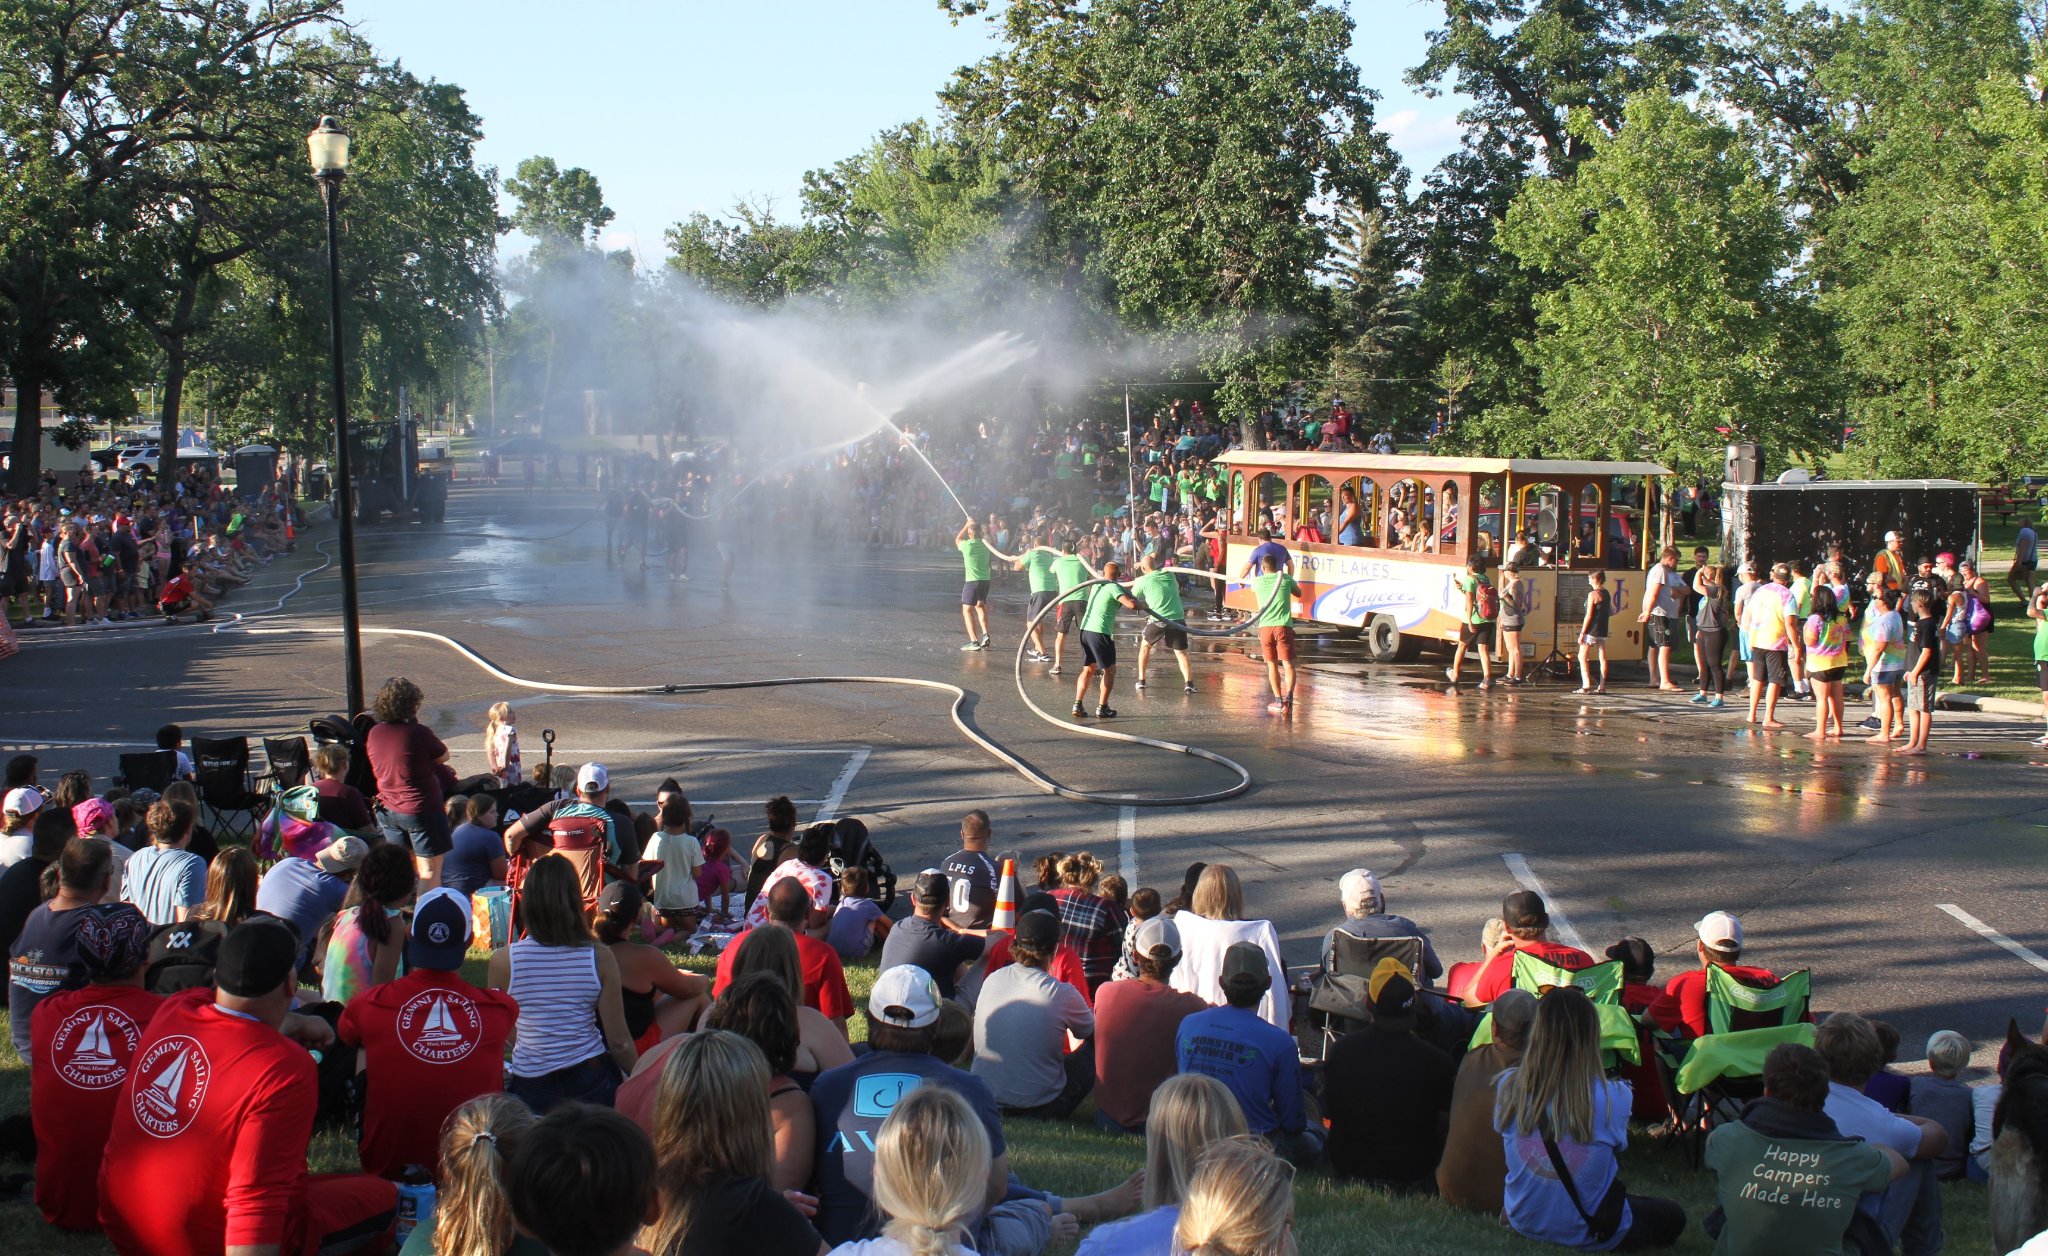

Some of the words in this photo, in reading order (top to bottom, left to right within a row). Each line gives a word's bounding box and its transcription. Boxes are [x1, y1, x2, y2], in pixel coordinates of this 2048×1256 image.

[1293, 555, 1335, 572] TROIT
[1341, 560, 1390, 578] LAKES
[1339, 586, 1417, 616] Jaycees
[948, 862, 976, 875] LPLS
[947, 876, 971, 913] 0
[55, 1012, 92, 1051] GEMINI
[106, 1012, 138, 1051] SAILING
[412, 1040, 471, 1059] CHARTERS
[1191, 1035, 1245, 1054] MONSTER
[1193, 1045, 1235, 1061] POWER
[63, 1064, 127, 1085] CHARTERS
[141, 1041, 184, 1073] GEMINI
[188, 1050, 206, 1110] SAILING
[135, 1092, 179, 1133] CHARTERS
[1763, 1144, 1820, 1167] Happy
[1753, 1163, 1831, 1188] Campers
[1740, 1182, 1790, 1205] Made
[1801, 1188, 1842, 1209] Here
